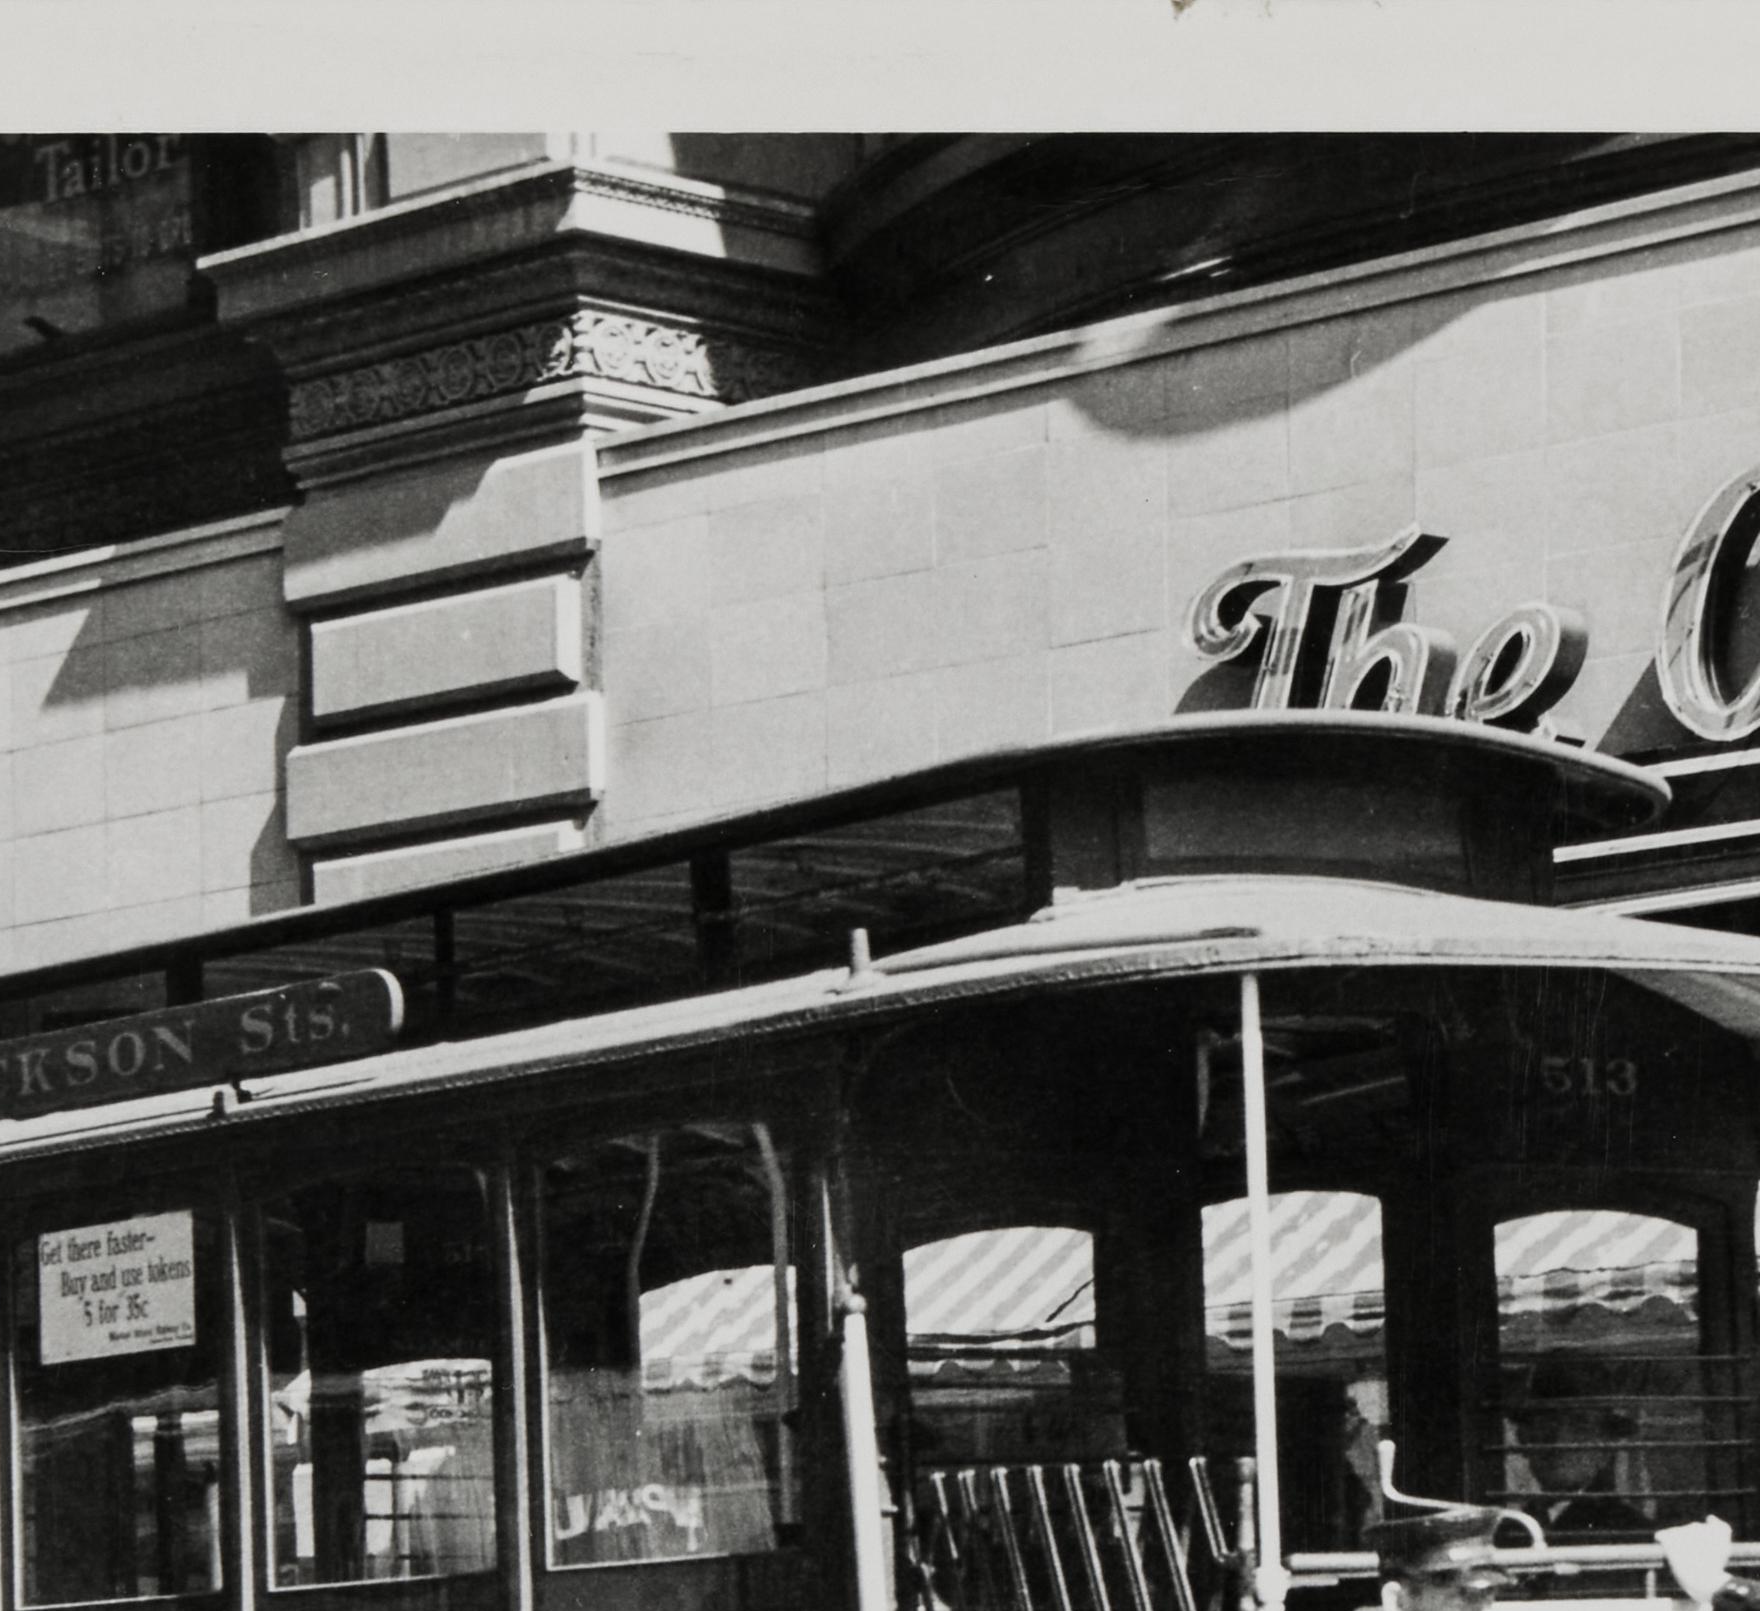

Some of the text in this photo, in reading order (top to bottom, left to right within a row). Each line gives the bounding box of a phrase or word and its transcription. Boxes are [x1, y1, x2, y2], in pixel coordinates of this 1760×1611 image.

[34, 134, 181, 203] Tailor
[1184, 522, 1590, 742] The
[240, 1002, 352, 1054] Sts.
[1539, 1055, 1640, 1097] 513
[41, 1241, 62, 1265] Get
[68, 1237, 102, 1262] there
[61, 1255, 192, 1301] Buy and use tokens
[83, 1301, 93, 1327] 5
[98, 1300, 120, 1325] for
